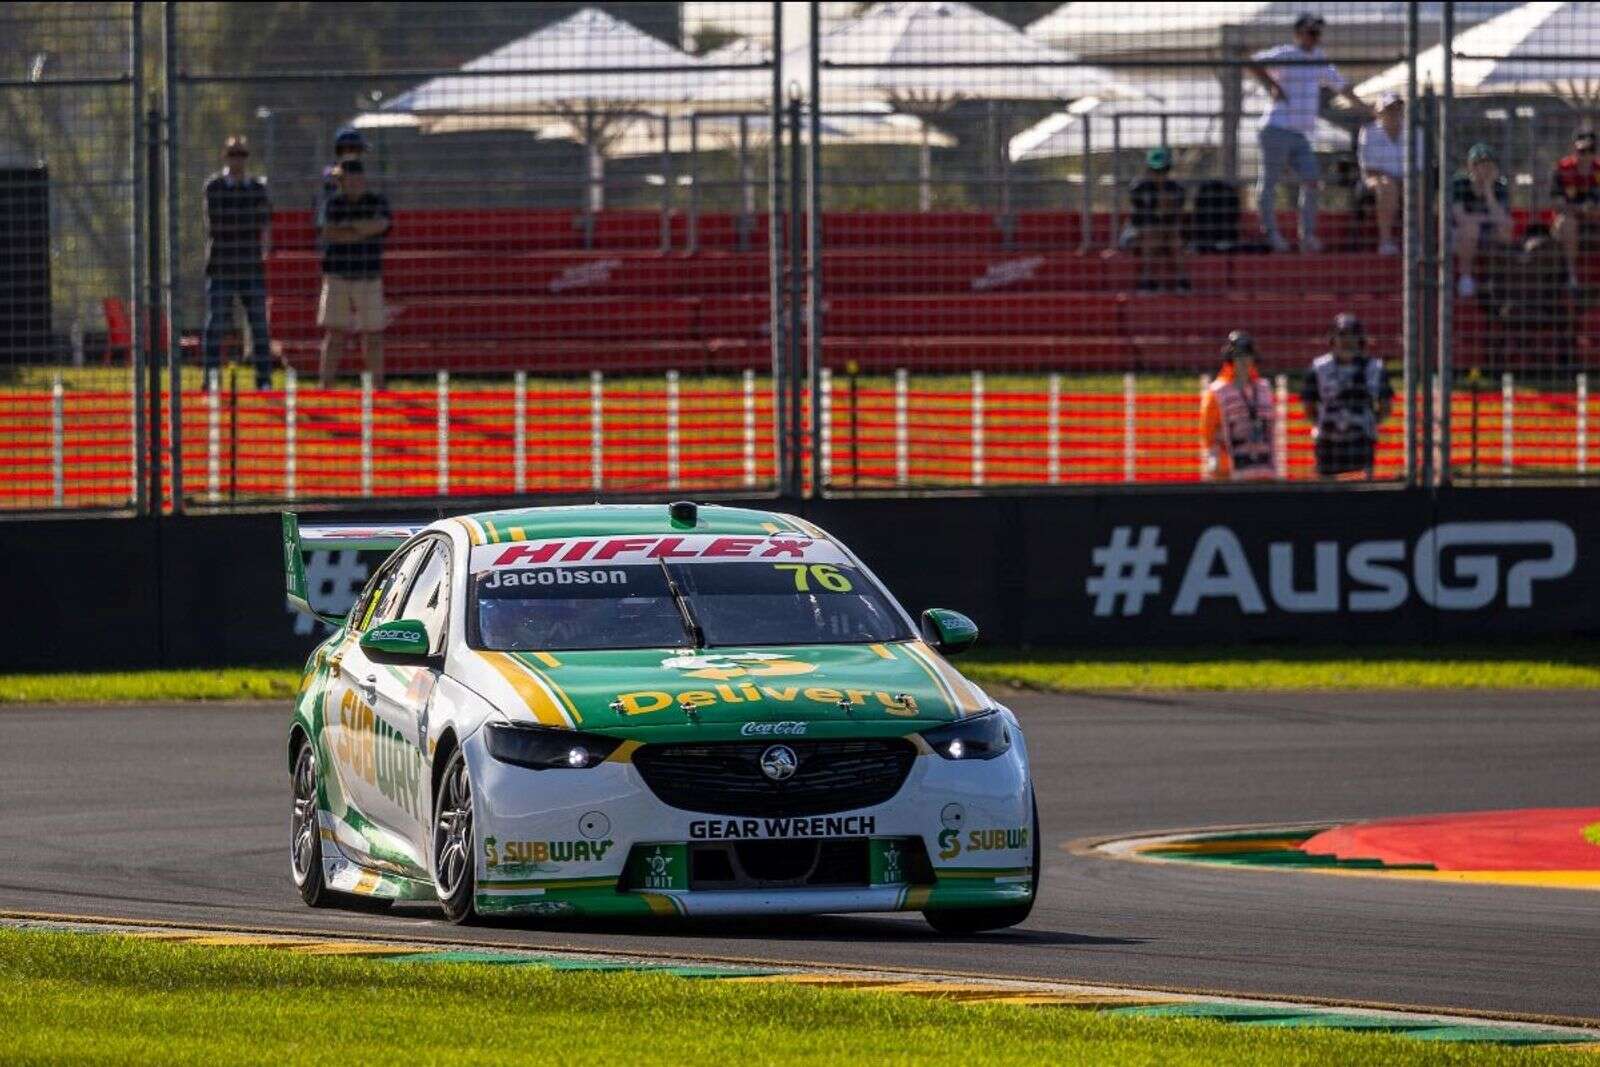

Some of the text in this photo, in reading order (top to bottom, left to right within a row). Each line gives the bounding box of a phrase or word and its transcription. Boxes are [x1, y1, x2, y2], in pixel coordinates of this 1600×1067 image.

[493, 536, 813, 566] HIFLEX
[486, 568, 627, 588] Jacobson
[773, 563, 853, 593] 76
[1086, 520, 1577, 616] #AusGP
[371, 630, 421, 642] sparco
[617, 682, 920, 717] Delivery
[689, 815, 876, 838] GEAR WRENCH
[505, 838, 614, 864] SUBWAY
